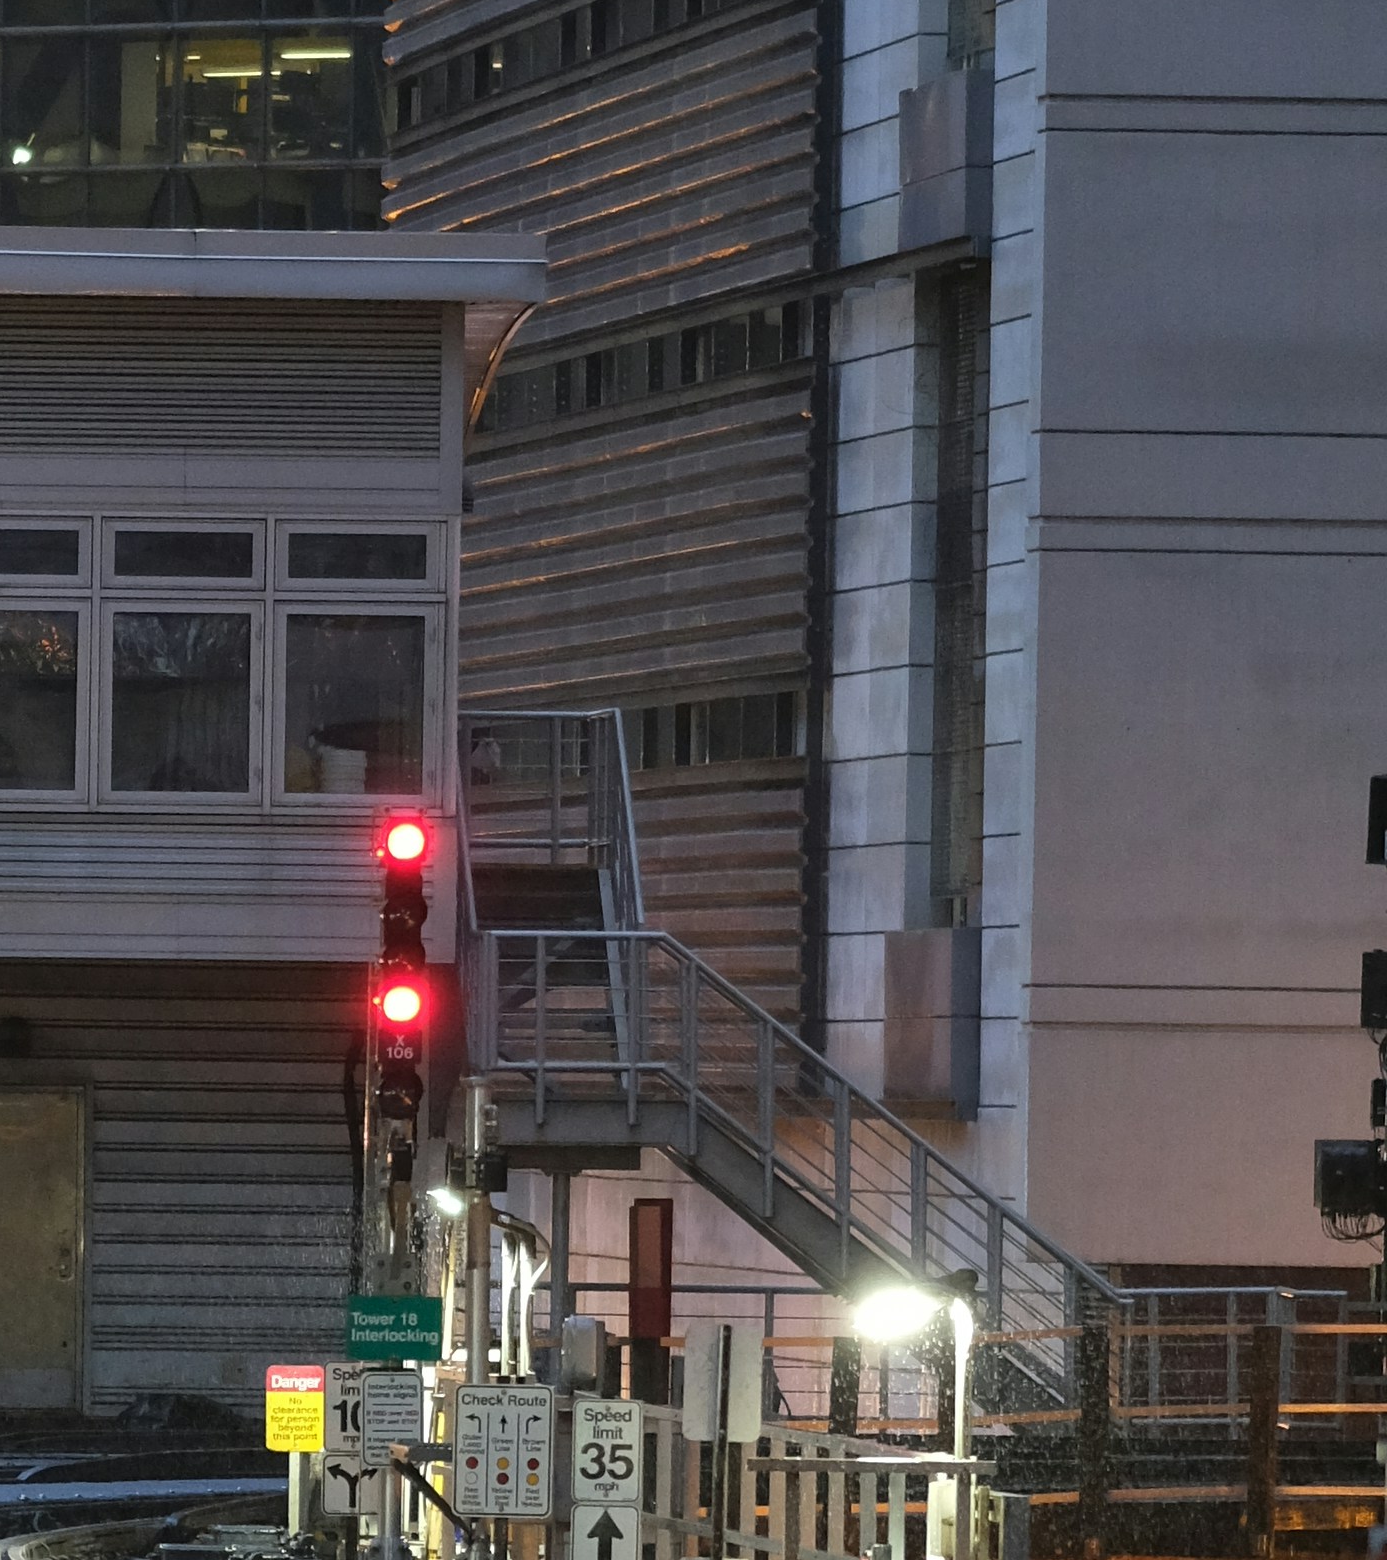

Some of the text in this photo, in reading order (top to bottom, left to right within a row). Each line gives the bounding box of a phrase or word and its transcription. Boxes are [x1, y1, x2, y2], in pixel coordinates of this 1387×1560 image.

[396, 1035, 405, 1047] X
[386, 1047, 414, 1059] 106
[351, 1312, 418, 1326] Tower 18
[351, 1328, 439, 1346] Interlocking
[271, 1375, 321, 1391] Danger
[288, 1397, 302, 1405] No
[461, 1394, 547, 1407] Check Route
[272, 1406, 318, 1414] clearance
[271, 1415, 319, 1425] for person
[584, 1408, 632, 1425] Speed
[293, 1433, 318, 1441] point
[593, 1426, 623, 1440] limit
[579, 1442, 634, 1480] 35
[594, 1482, 619, 1492] mph
